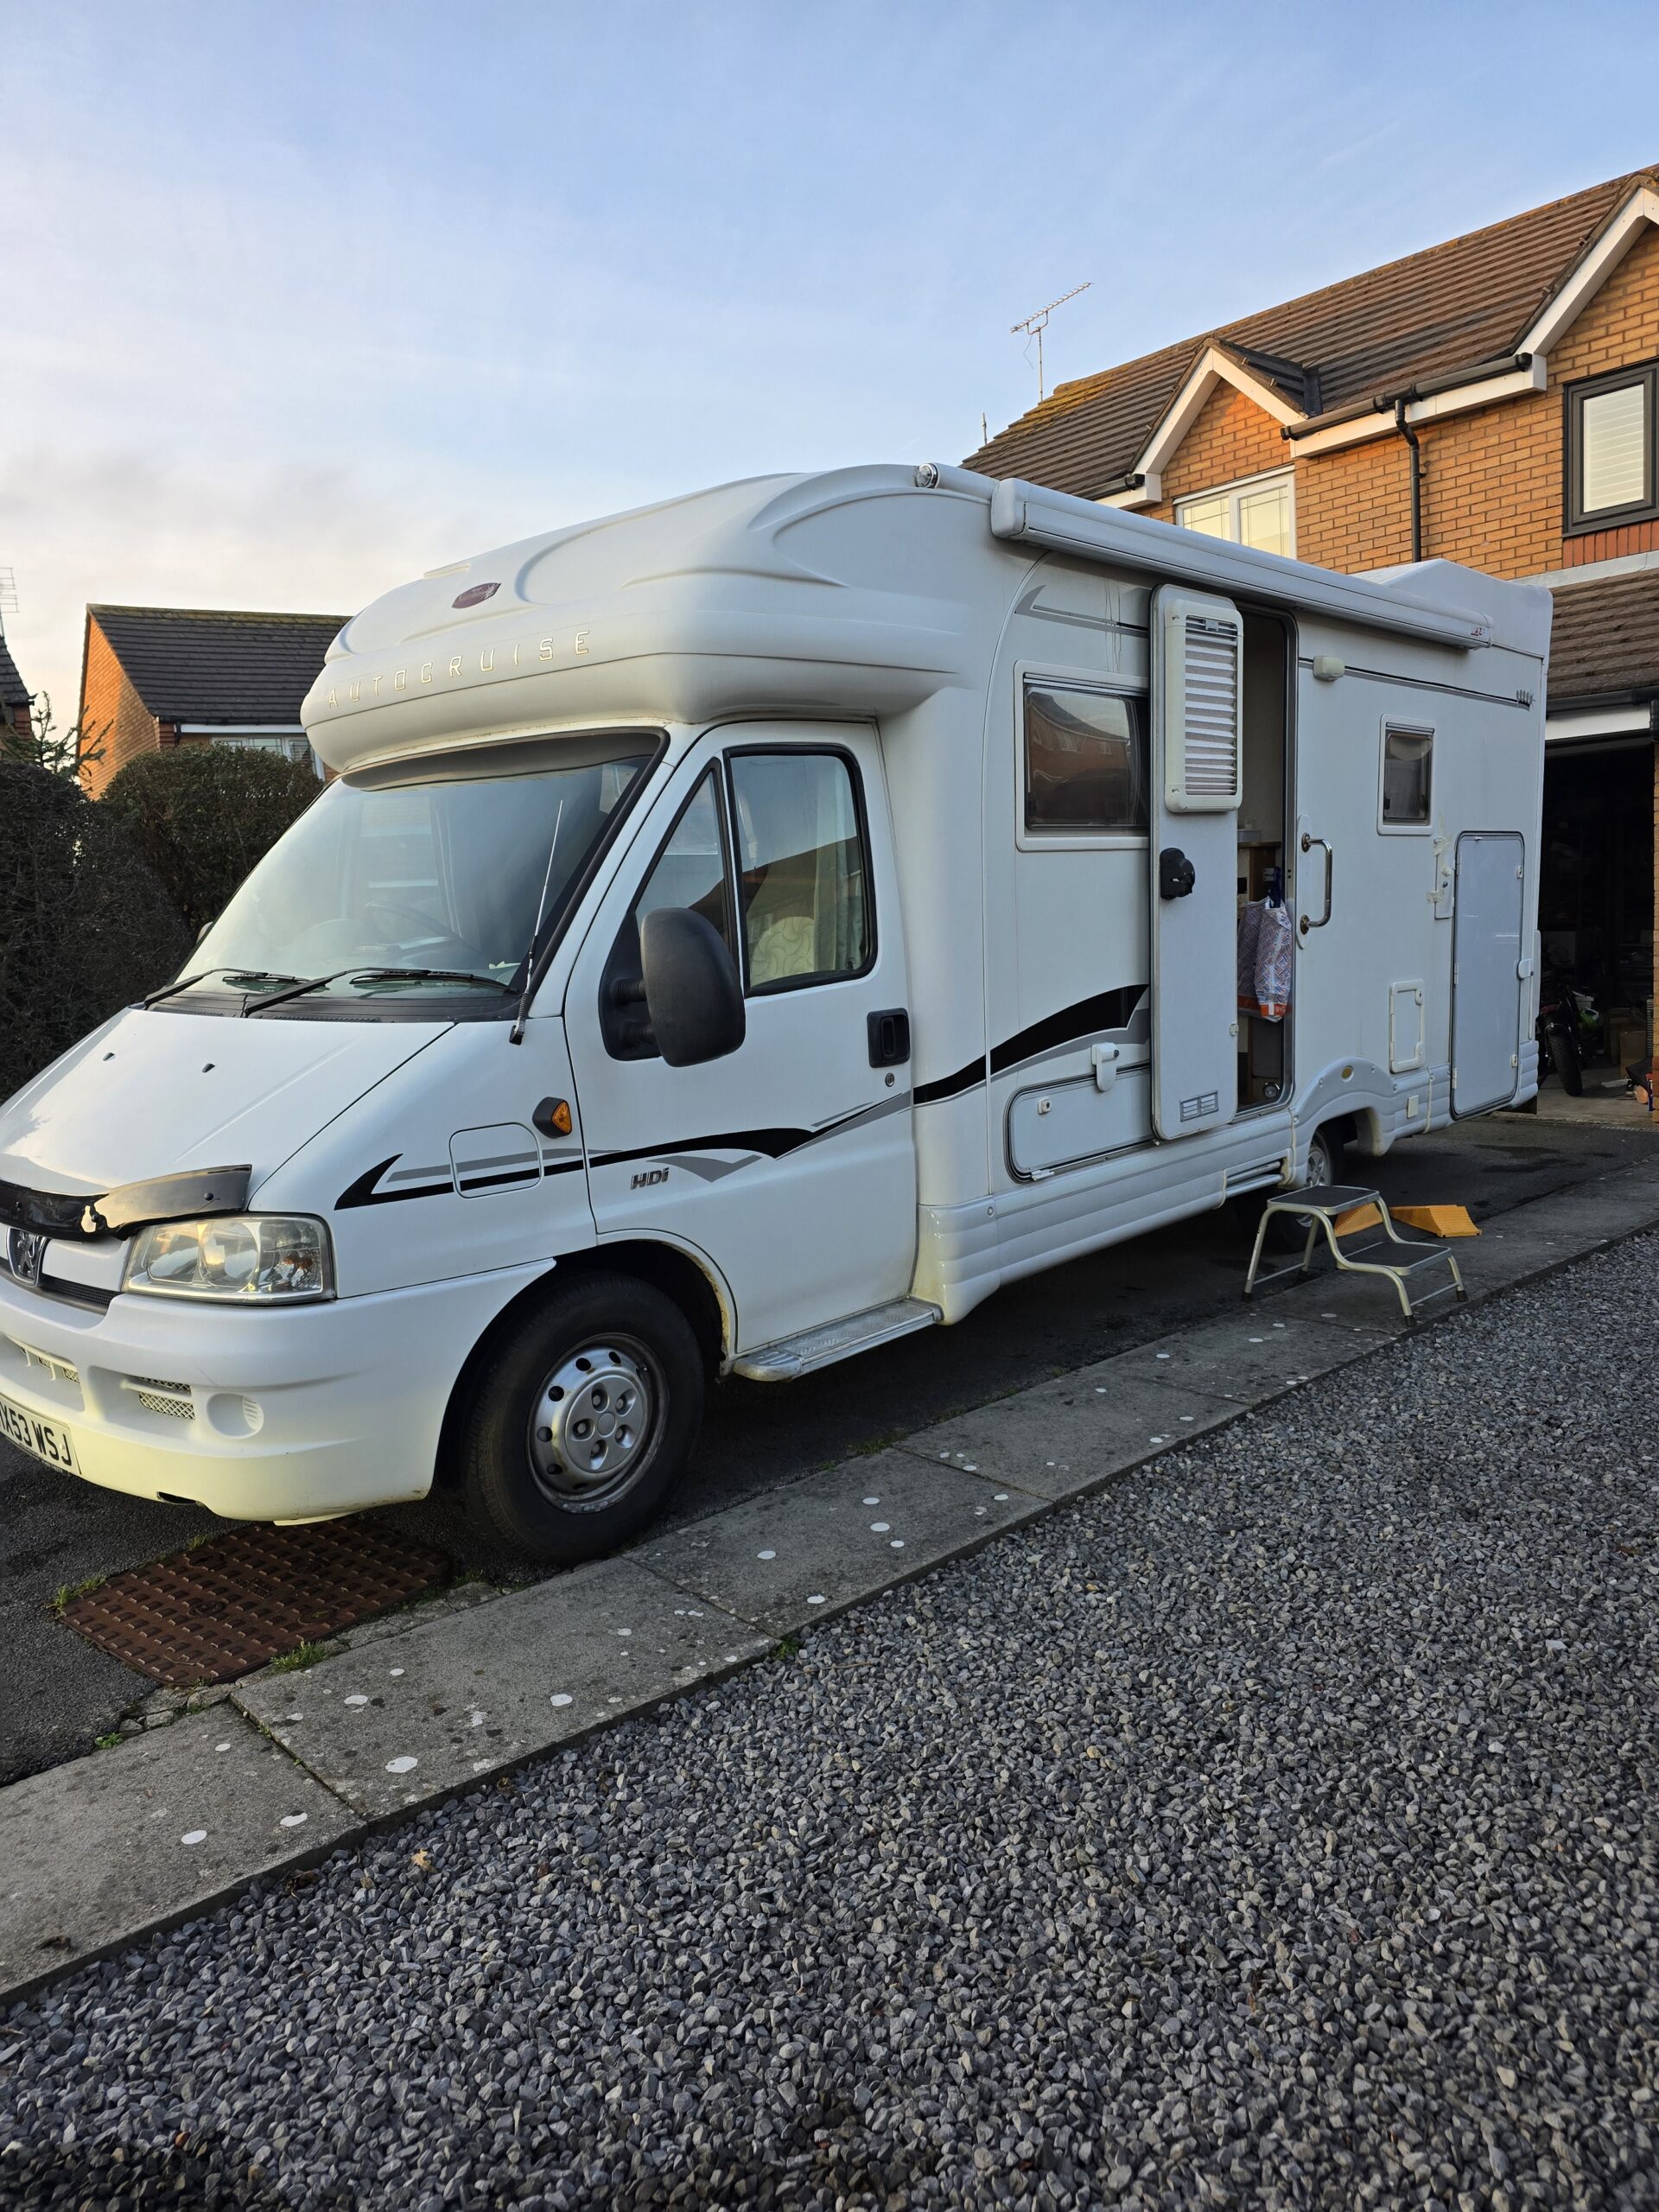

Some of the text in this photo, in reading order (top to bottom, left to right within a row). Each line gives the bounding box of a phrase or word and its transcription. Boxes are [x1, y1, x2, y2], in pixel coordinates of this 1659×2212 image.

[328, 630, 591, 709] AUTOCRUISE
[631, 1167, 670, 1190] HDi
[31, 1420, 72, 1466] WSJ
